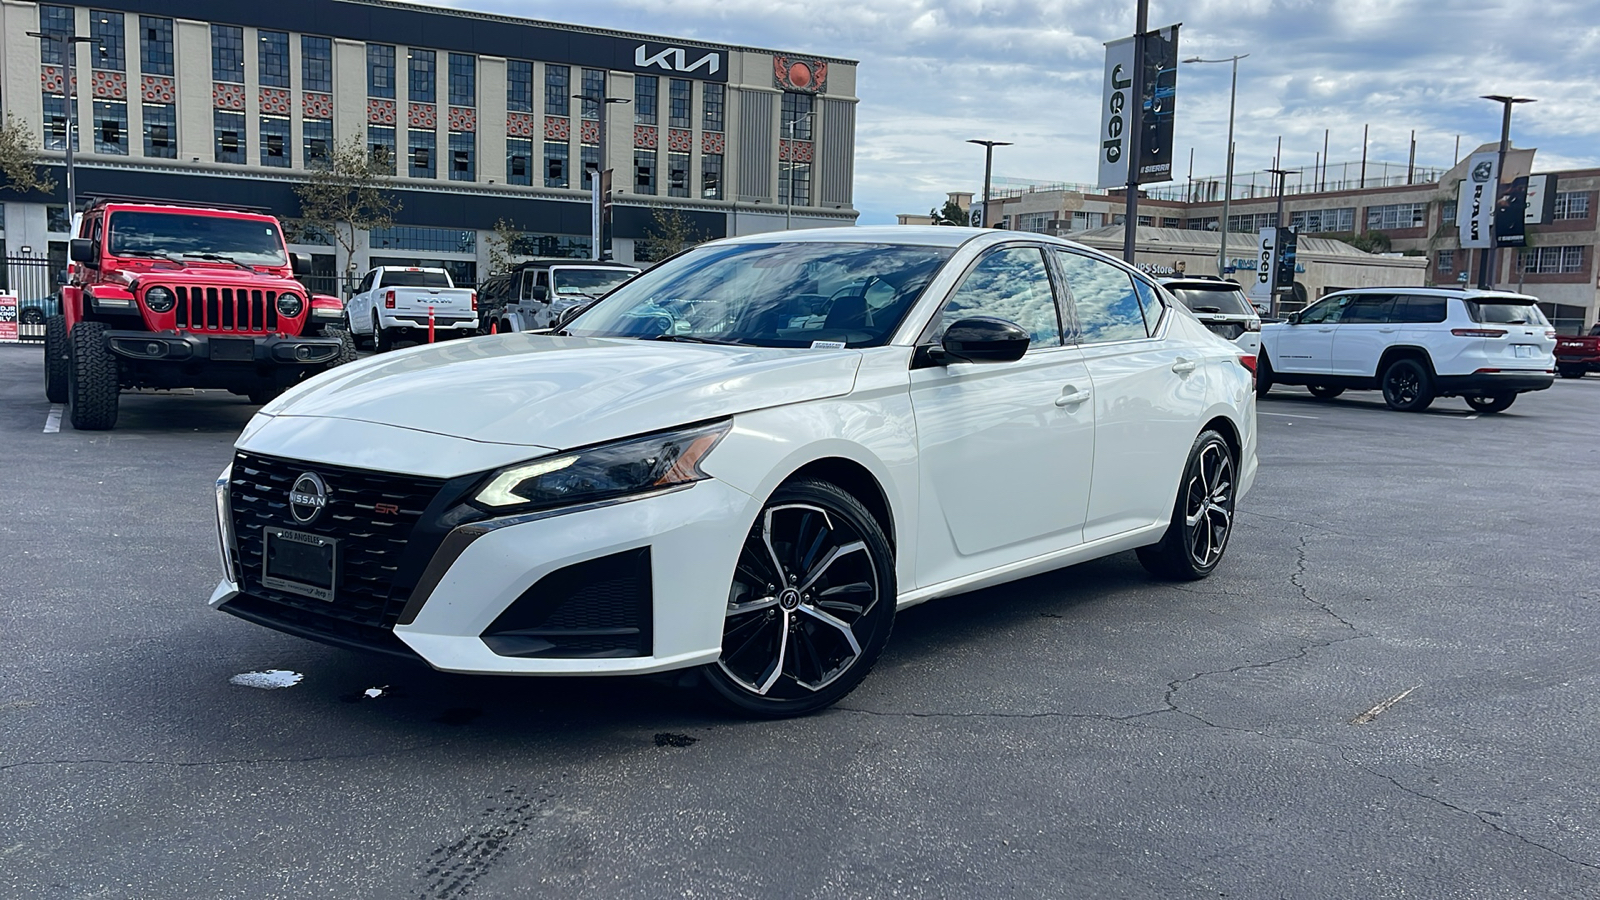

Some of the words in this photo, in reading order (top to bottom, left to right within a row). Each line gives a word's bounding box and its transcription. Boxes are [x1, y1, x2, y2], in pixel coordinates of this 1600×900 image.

[635, 44, 720, 75] KIA
[1103, 64, 1132, 163] Jeep
[1145, 163, 1170, 173] SIERRA
[1471, 185, 1483, 240] RAM
[1258, 238, 1274, 283] Jeep
[1152, 264, 1173, 274] Store
[290, 493, 326, 506] NISSAN
[374, 503, 398, 515] SR
[280, 530, 293, 539] LOS
[294, 531, 321, 545] ANGELES
